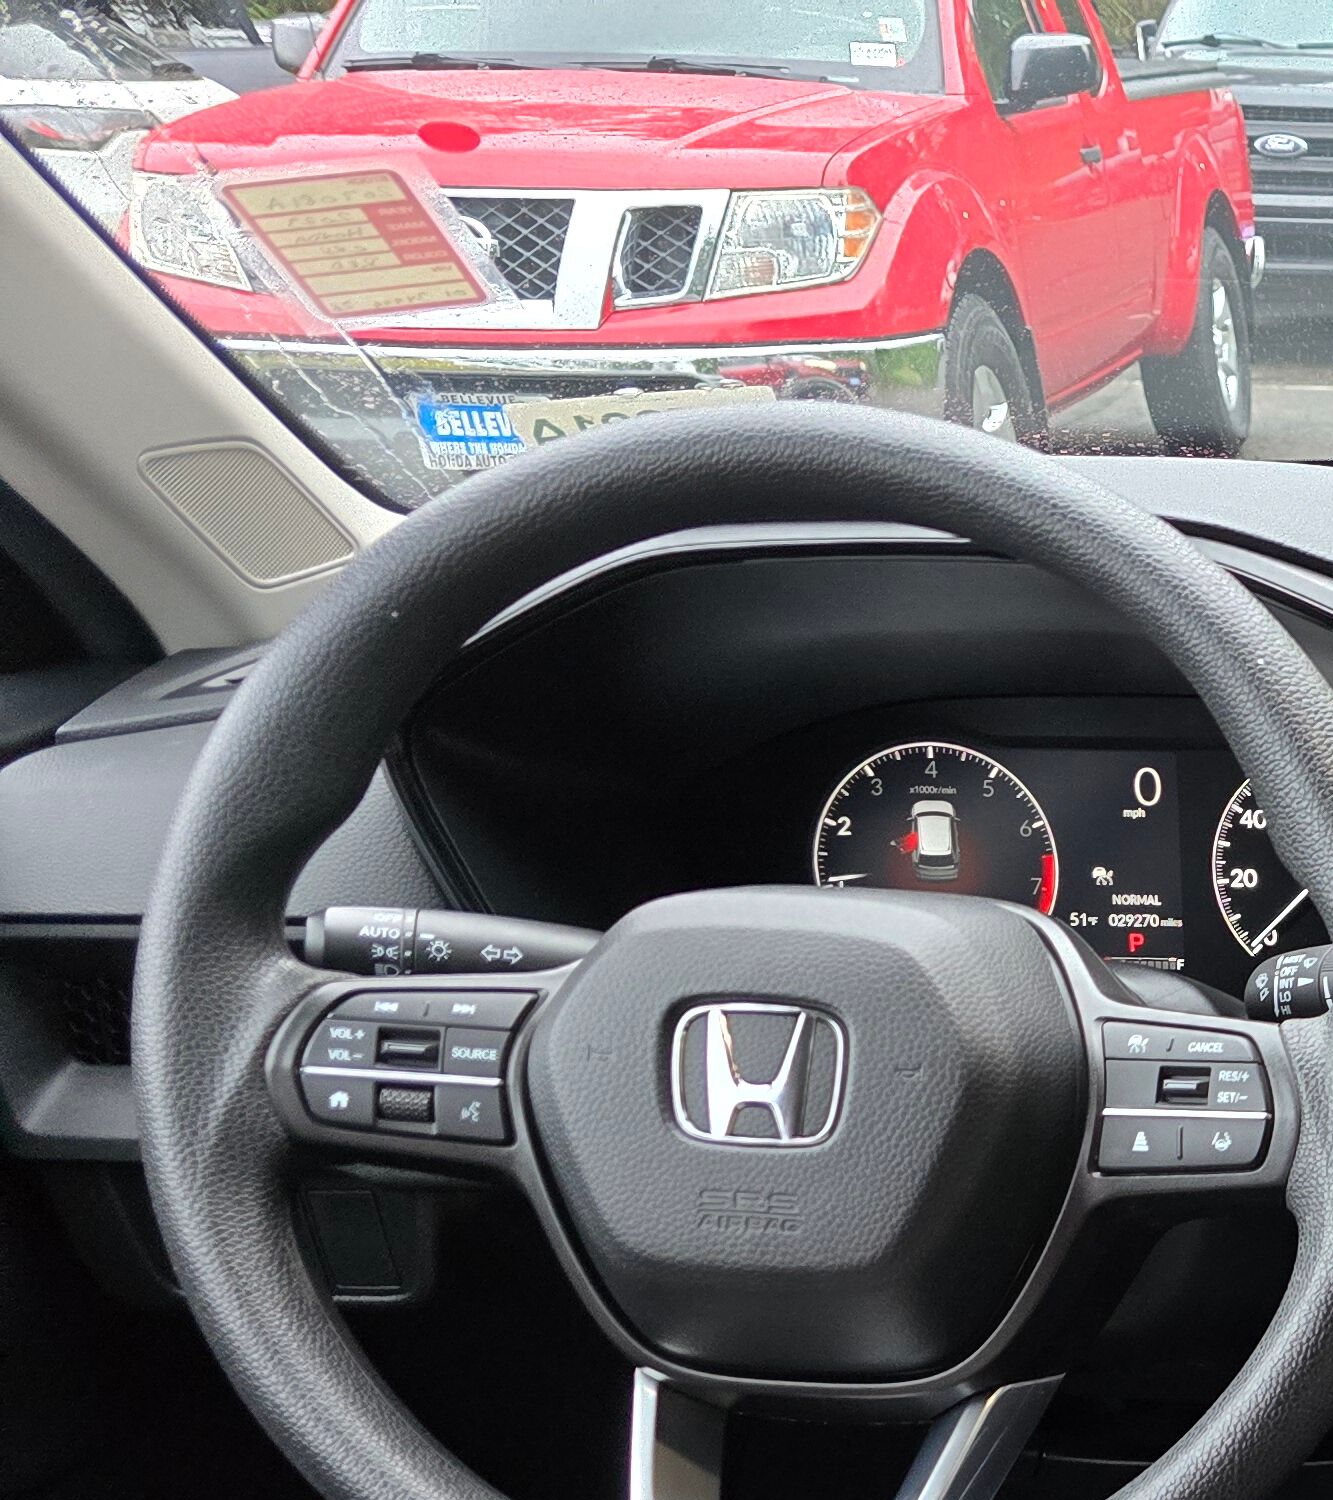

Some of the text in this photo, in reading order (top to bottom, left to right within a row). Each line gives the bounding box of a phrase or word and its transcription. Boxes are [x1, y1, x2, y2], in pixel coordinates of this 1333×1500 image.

[440, 394, 517, 405] BELLEVUE
[435, 410, 518, 437] BELLEV
[924, 760, 938, 779] 4
[871, 778, 883, 796] 3
[909, 786, 957, 795] x1000r/min
[983, 780, 994, 797] 5
[1133, 767, 1162, 807] 0
[1123, 808, 1146, 819] mph
[1239, 810, 1267, 829] 40
[837, 816, 852, 836] 2
[1020, 820, 1032, 837] 6
[1230, 868, 1258, 888] 20
[1031, 878, 1042, 896] 7
[1112, 894, 1162, 906] NORMAL
[1108, 914, 1183, 928] 029270 miles
[359, 925, 400, 939] AUTO
[1127, 933, 1145, 952] P
[1176, 959, 1184, 970] F
[1280, 967, 1298, 977] OFF
[1280, 977, 1295, 988] INT
[1280, 992, 1291, 1002] LO
[1281, 1005, 1292, 1016] HI
[452, 1047, 497, 1061] SOURCE
[1187, 1041, 1224, 1054] CANCEL
[1218, 1070, 1250, 1083] RES/+
[698, 1214, 801, 1234] AIRBAG
